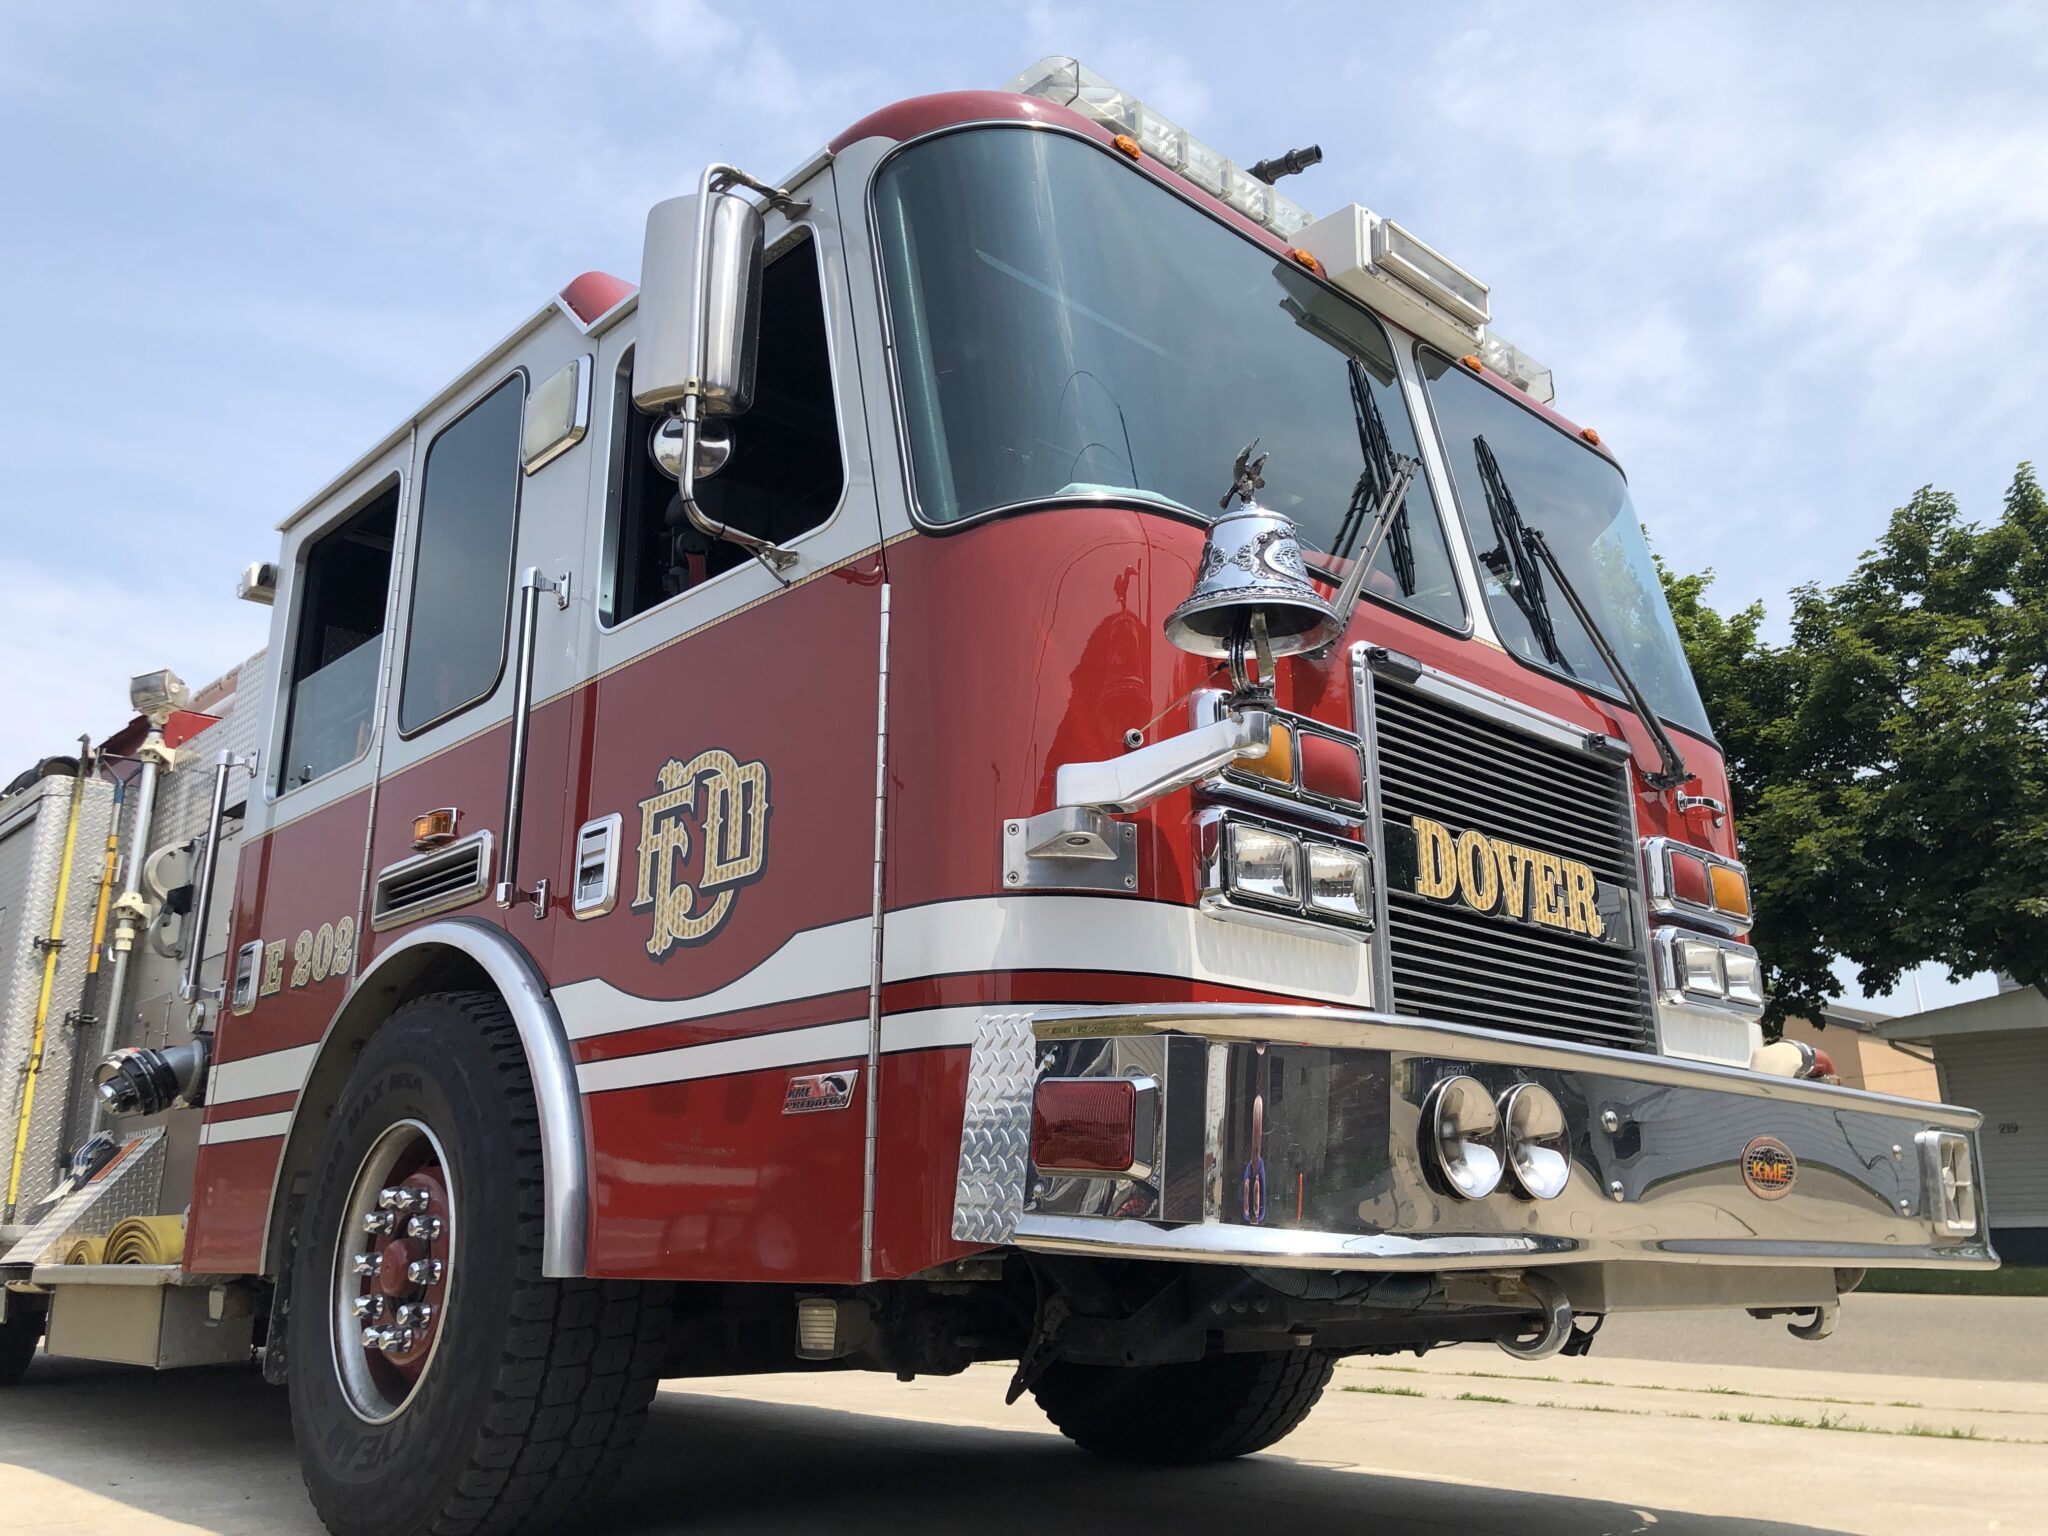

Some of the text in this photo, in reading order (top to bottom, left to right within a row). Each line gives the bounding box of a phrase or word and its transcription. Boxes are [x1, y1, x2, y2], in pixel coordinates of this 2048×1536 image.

[1411, 815, 1605, 940] DOVER
[259, 915, 355, 997] E 202
[346, 1078, 385, 1137] MAX
[1752, 1161, 1788, 1182] KME
